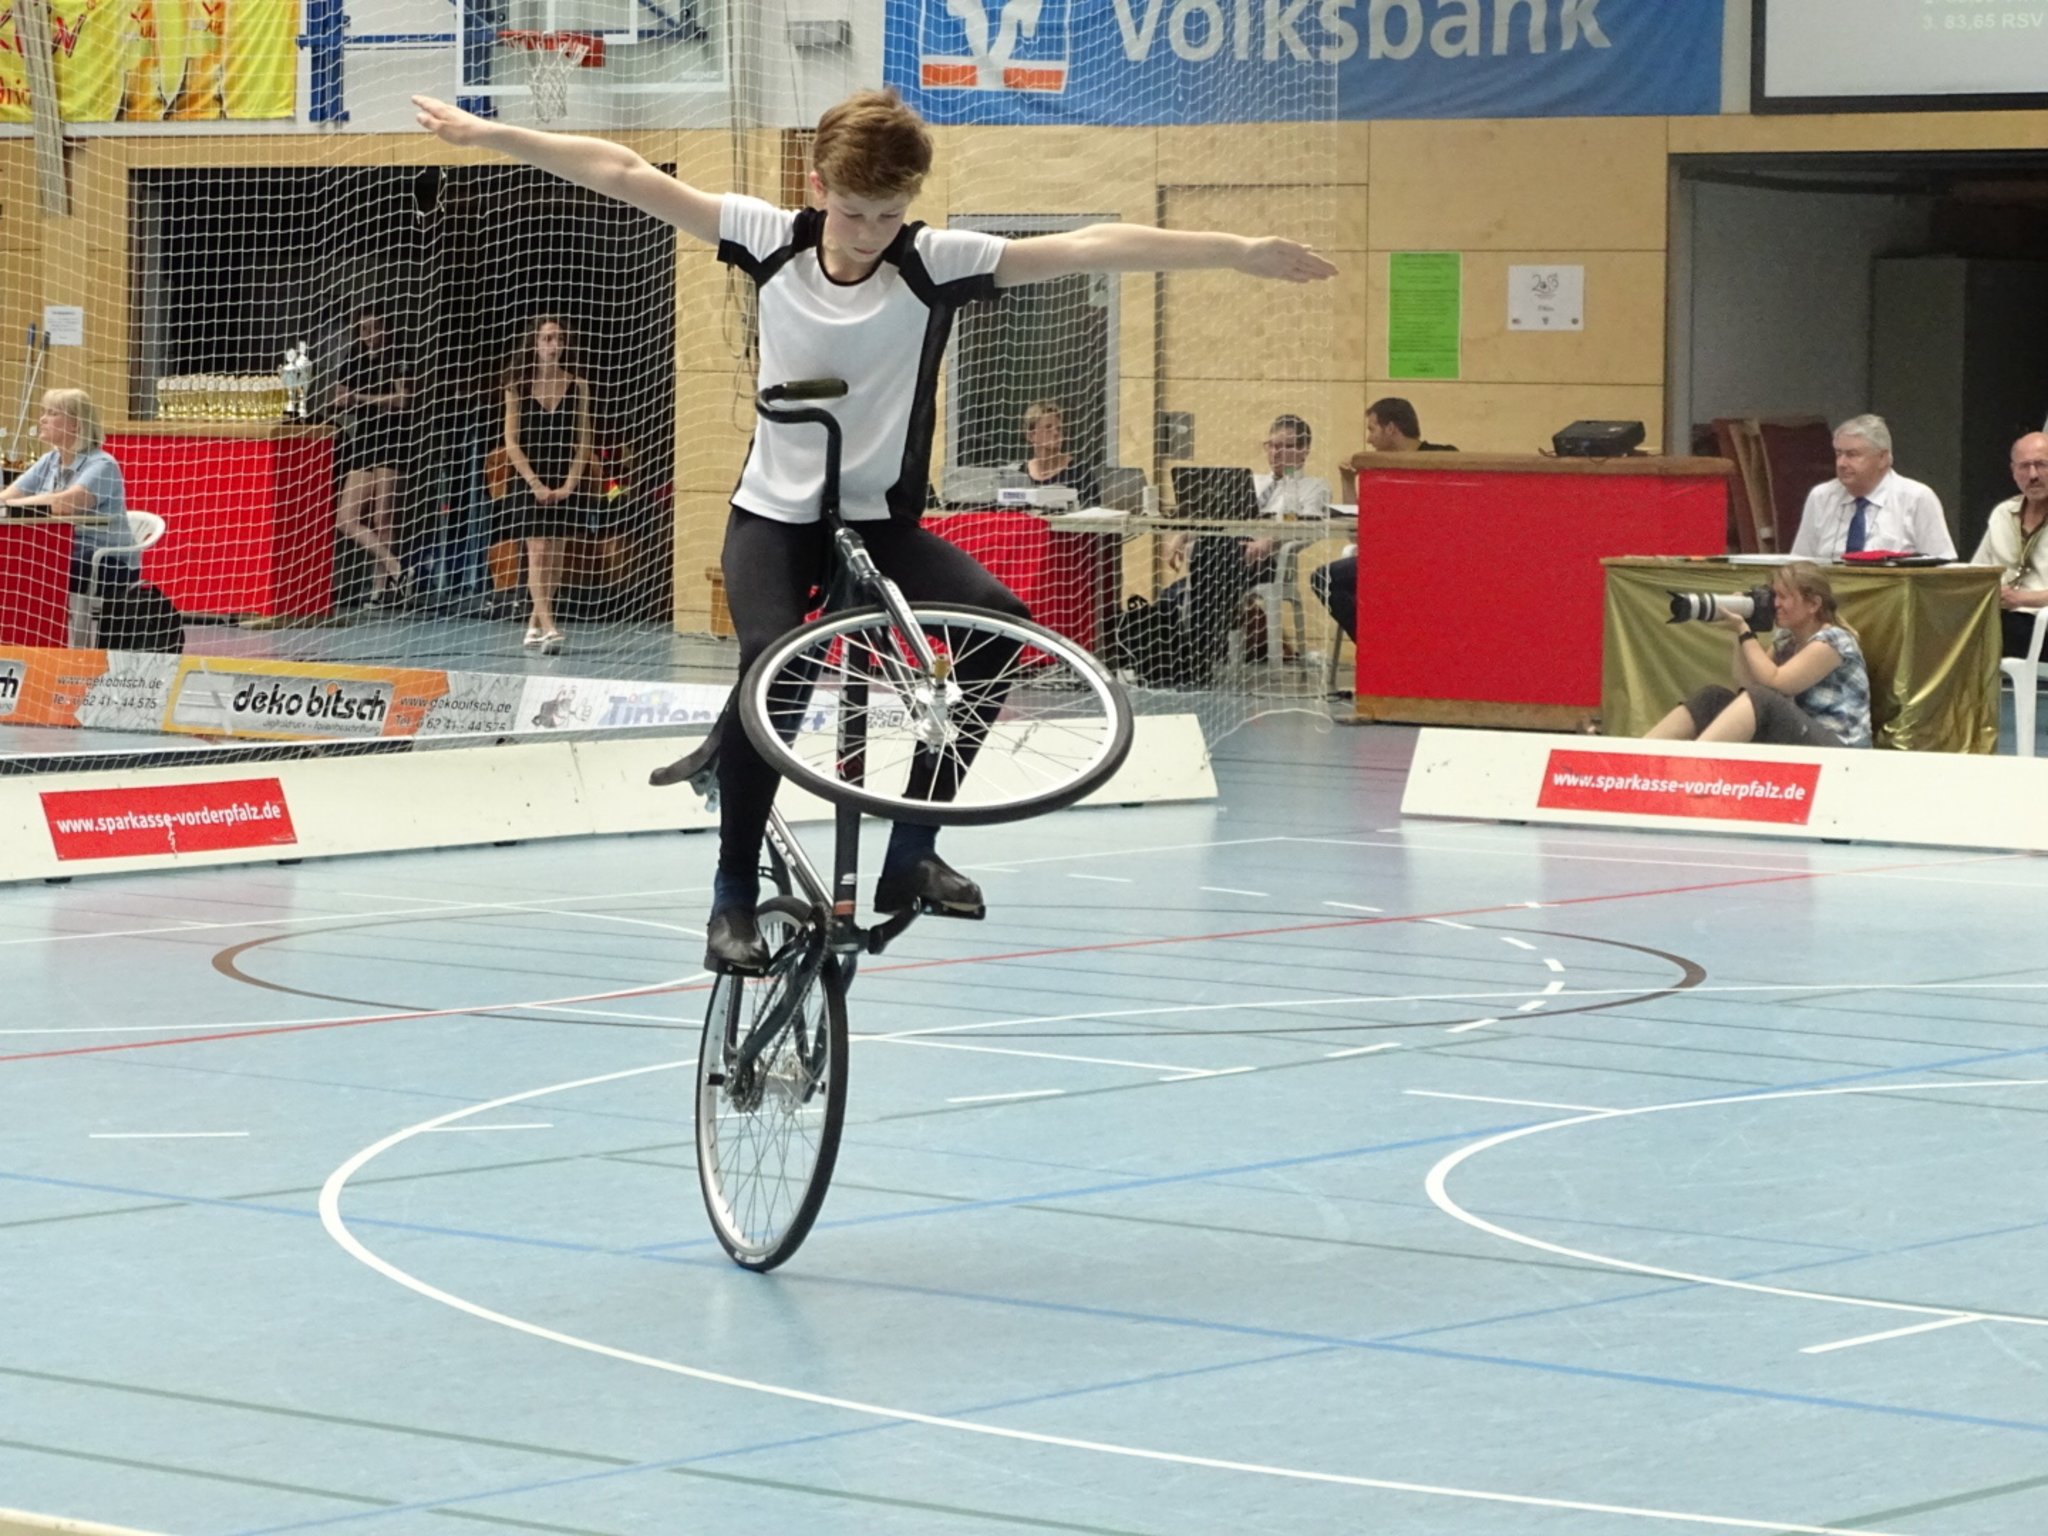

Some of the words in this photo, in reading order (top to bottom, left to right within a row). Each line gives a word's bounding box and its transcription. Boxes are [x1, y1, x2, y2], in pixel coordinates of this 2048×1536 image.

[1113, 0, 1611, 63] Volksbank
[2002, 12, 2044, 29] RSV
[606, 696, 721, 725] Tinten
[1553, 771, 1805, 801] www.sparkasse-vorderpfalz.de
[56, 801, 281, 836] www.sparkasse-vorderpfalz.de
